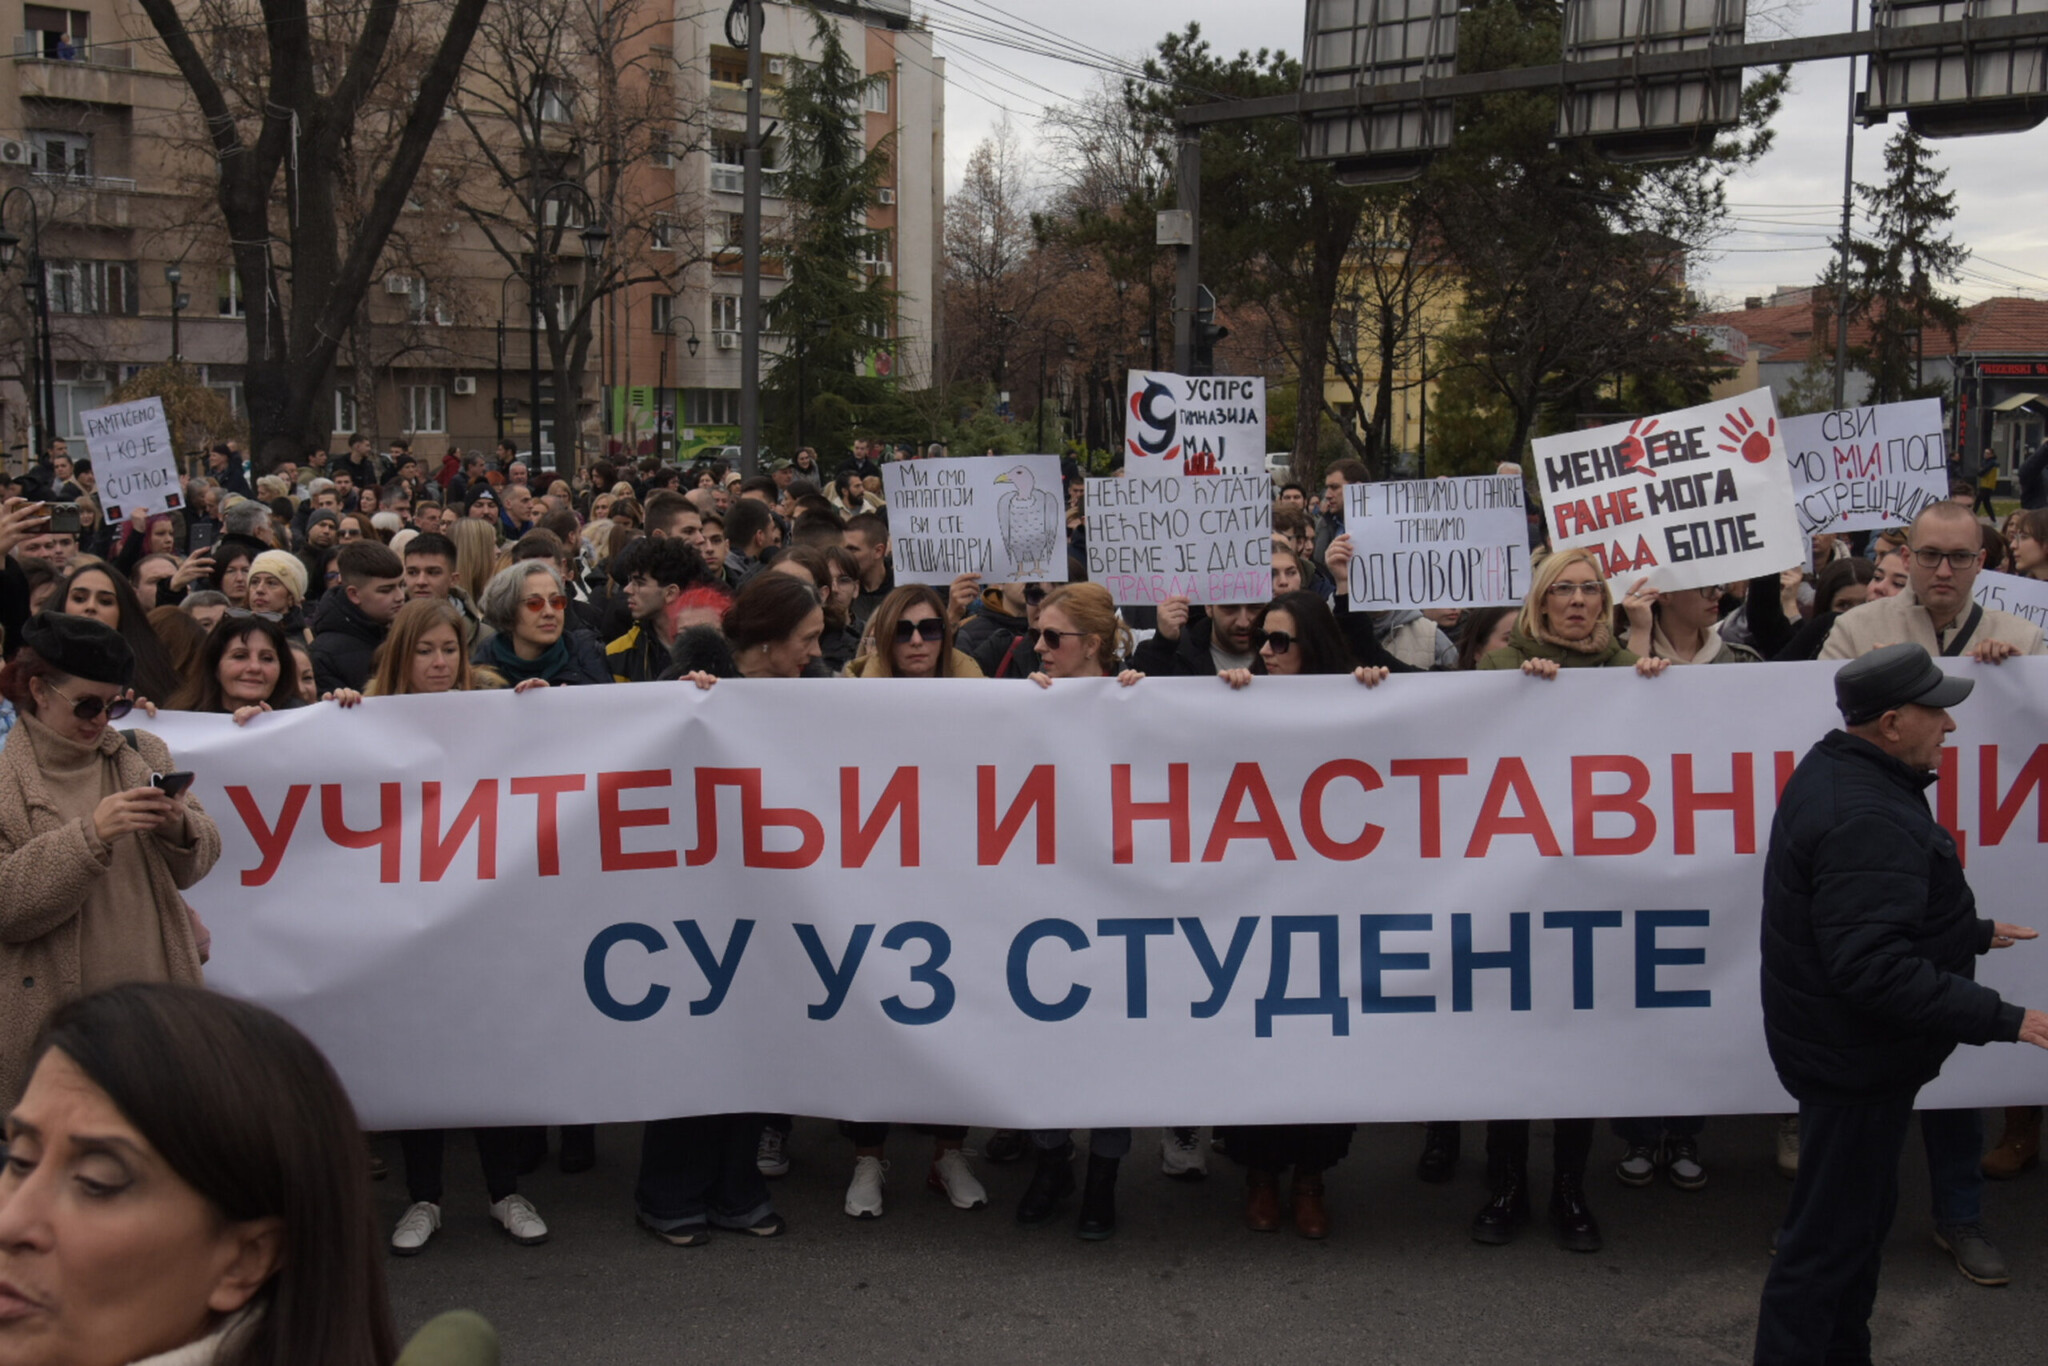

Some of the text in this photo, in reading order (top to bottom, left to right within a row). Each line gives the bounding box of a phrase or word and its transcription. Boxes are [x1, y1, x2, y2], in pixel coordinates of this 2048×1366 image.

[1185, 379, 1254, 402] УСПРС
[1180, 407, 1259, 426] ГИМНАЗИЈА
[1822, 407, 1877, 442] СВИ
[1544, 441, 1639, 494] МЕНЕ
[1788, 433, 1946, 484] МО МИ ПОД
[1086, 476, 1271, 508] НЕЋЕМО ЋУТАТИ
[1351, 476, 1524, 518] НЕ ТРАЖИМО СТАНОВЕ
[1553, 468, 1739, 540] РАНЕ МОГА
[938, 515, 965, 534] СТЕ
[1087, 503, 1270, 543] НЕЋЕМО СТАТИ
[1394, 516, 1466, 544] ТРАЖИМО
[1663, 512, 1765, 563] БОЛЕ
[896, 537, 993, 573] ЛЕШИНАРИ
[1088, 536, 1271, 574] ВРЕМЕ ЈЕ ДА СЕ
[1105, 571, 1271, 604] ПРАВДА ВРАТИ
[223, 766, 920, 887] УЧИТЕЉИ
[976, 763, 1057, 866] И
[583, 908, 1712, 1038] СУ УЗ СТУДЕНТЕ
